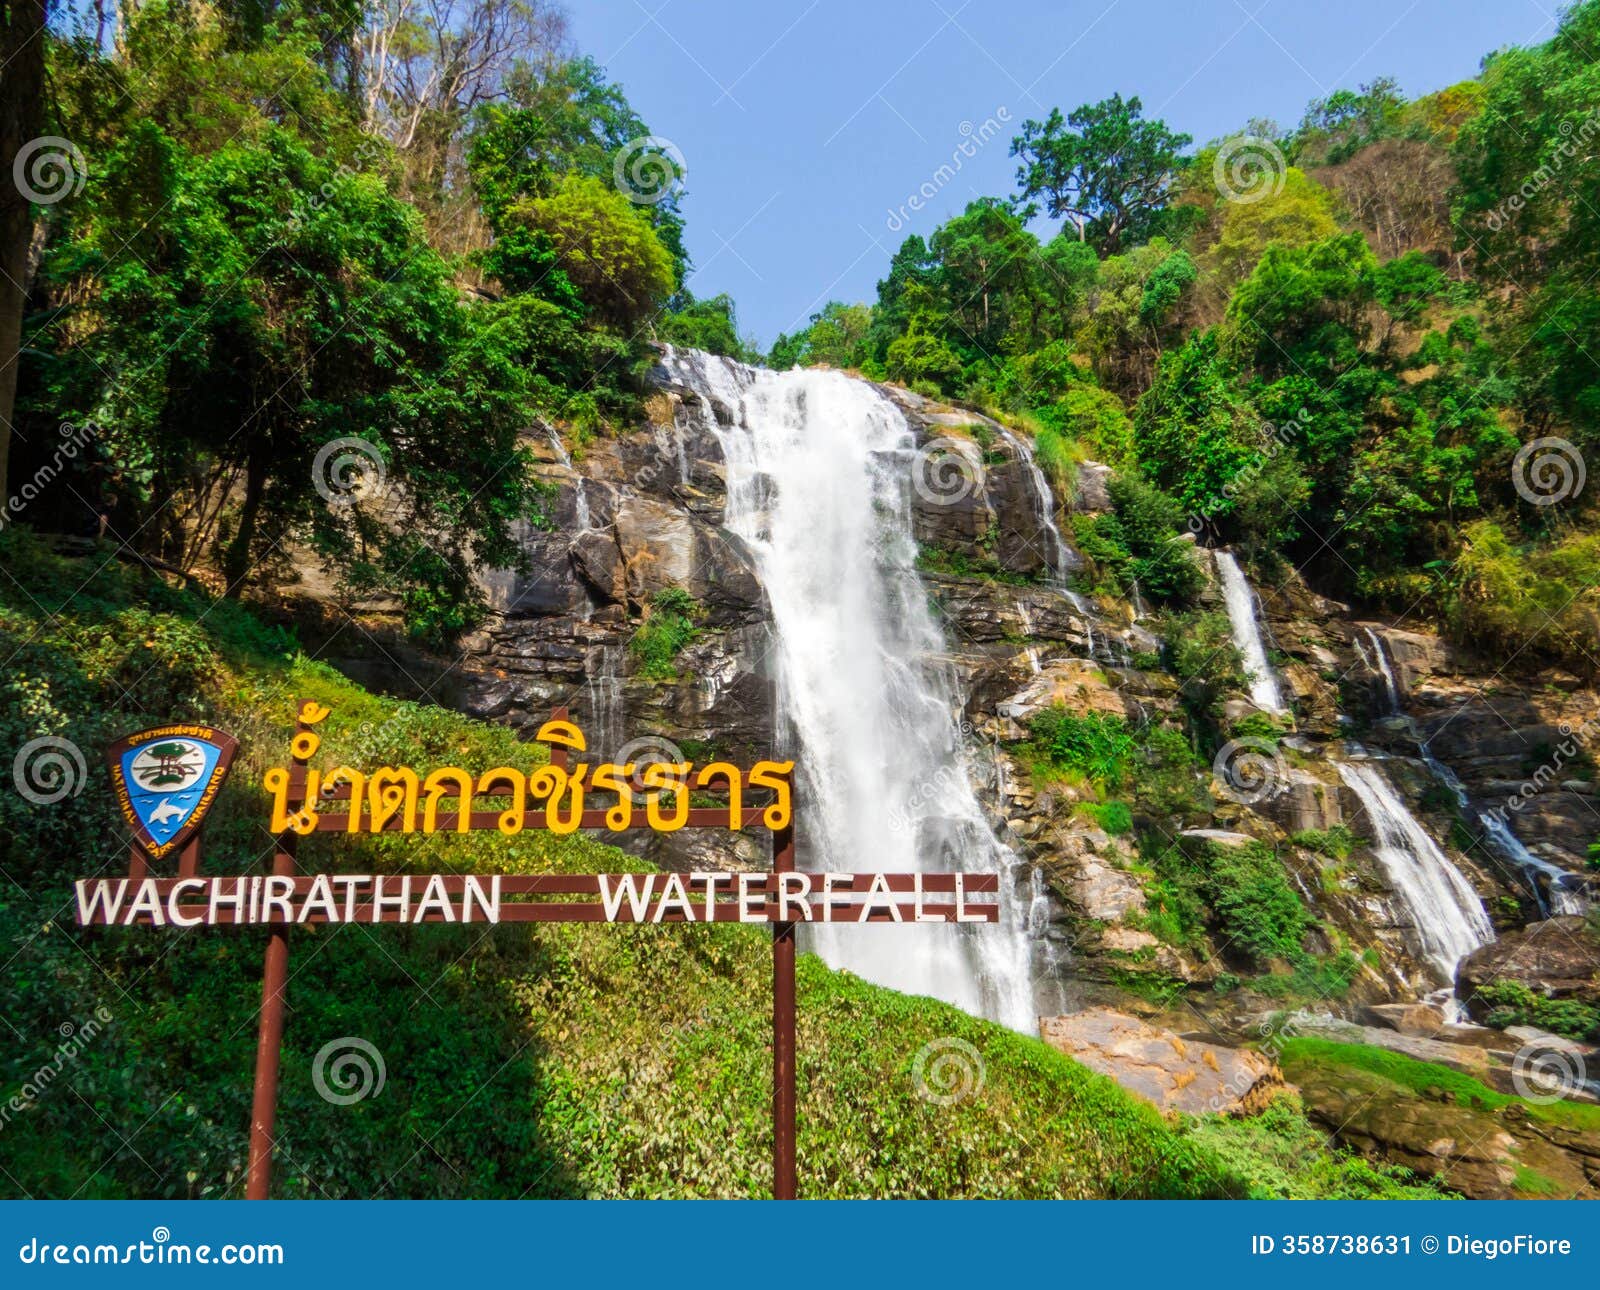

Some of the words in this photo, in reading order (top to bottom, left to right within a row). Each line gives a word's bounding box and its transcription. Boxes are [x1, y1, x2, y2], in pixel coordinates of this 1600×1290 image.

[112, 764, 137, 825] NATIONAL
[183, 766, 225, 829] THAILAND
[263, 702, 795, 835] น้ำตกวชิรธาร
[146, 841, 176, 861] PARK
[75, 874, 500, 927] WACHIRATHAN
[598, 871, 988, 923] WATERFALL
